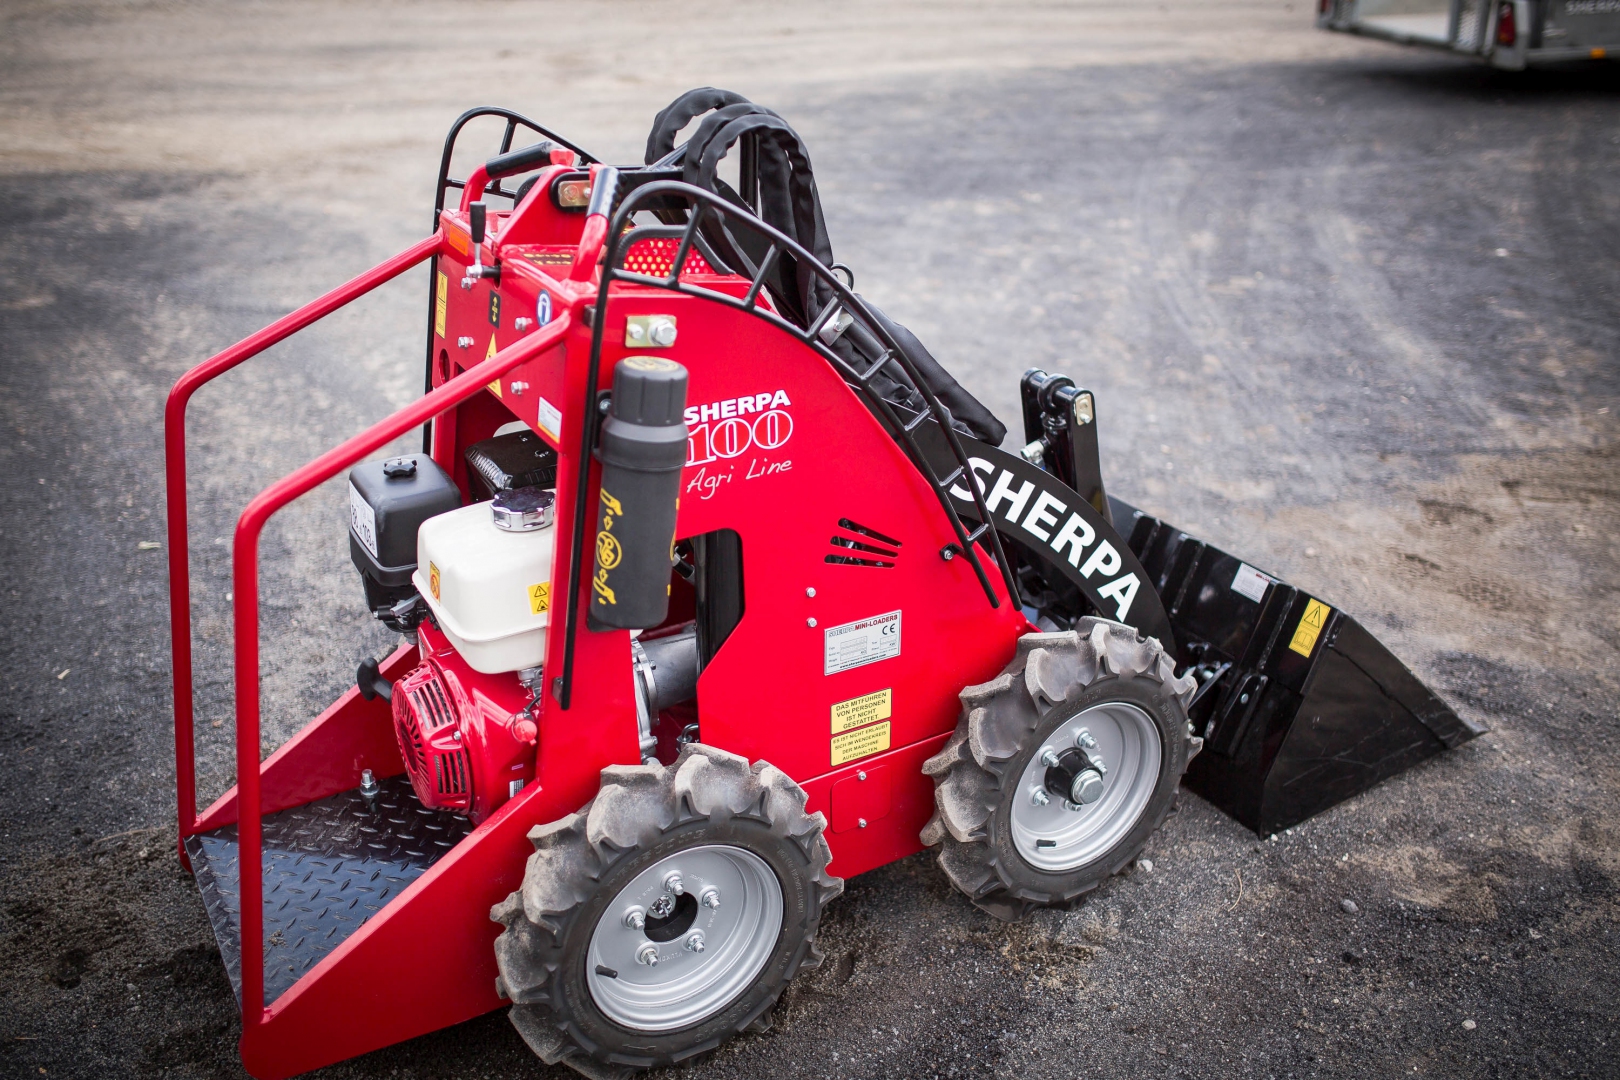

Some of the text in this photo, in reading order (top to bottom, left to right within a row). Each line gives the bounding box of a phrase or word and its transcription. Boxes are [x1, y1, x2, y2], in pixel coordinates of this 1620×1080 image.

[684, 389, 791, 426] SHERPA
[684, 409, 794, 468] 100
[686, 457, 793, 500] Agri Line
[949, 456, 1141, 623] SHERPA
[854, 614, 898, 631] MINI-LOADERS
[835, 691, 887, 712] DAS MITFÜHREN
[836, 699, 886, 718] VON PERSONEN
[846, 708, 876, 722] IST NICHT
[849, 731, 864, 739] NICHT
[865, 723, 888, 734] ERLAUBT
[834, 742, 847, 751] SICH
[854, 731, 887, 744] WENDEKREIS
[842, 739, 879, 755] DER MASCHINE
[842, 746, 878, 761] AUFZUHALTEN
